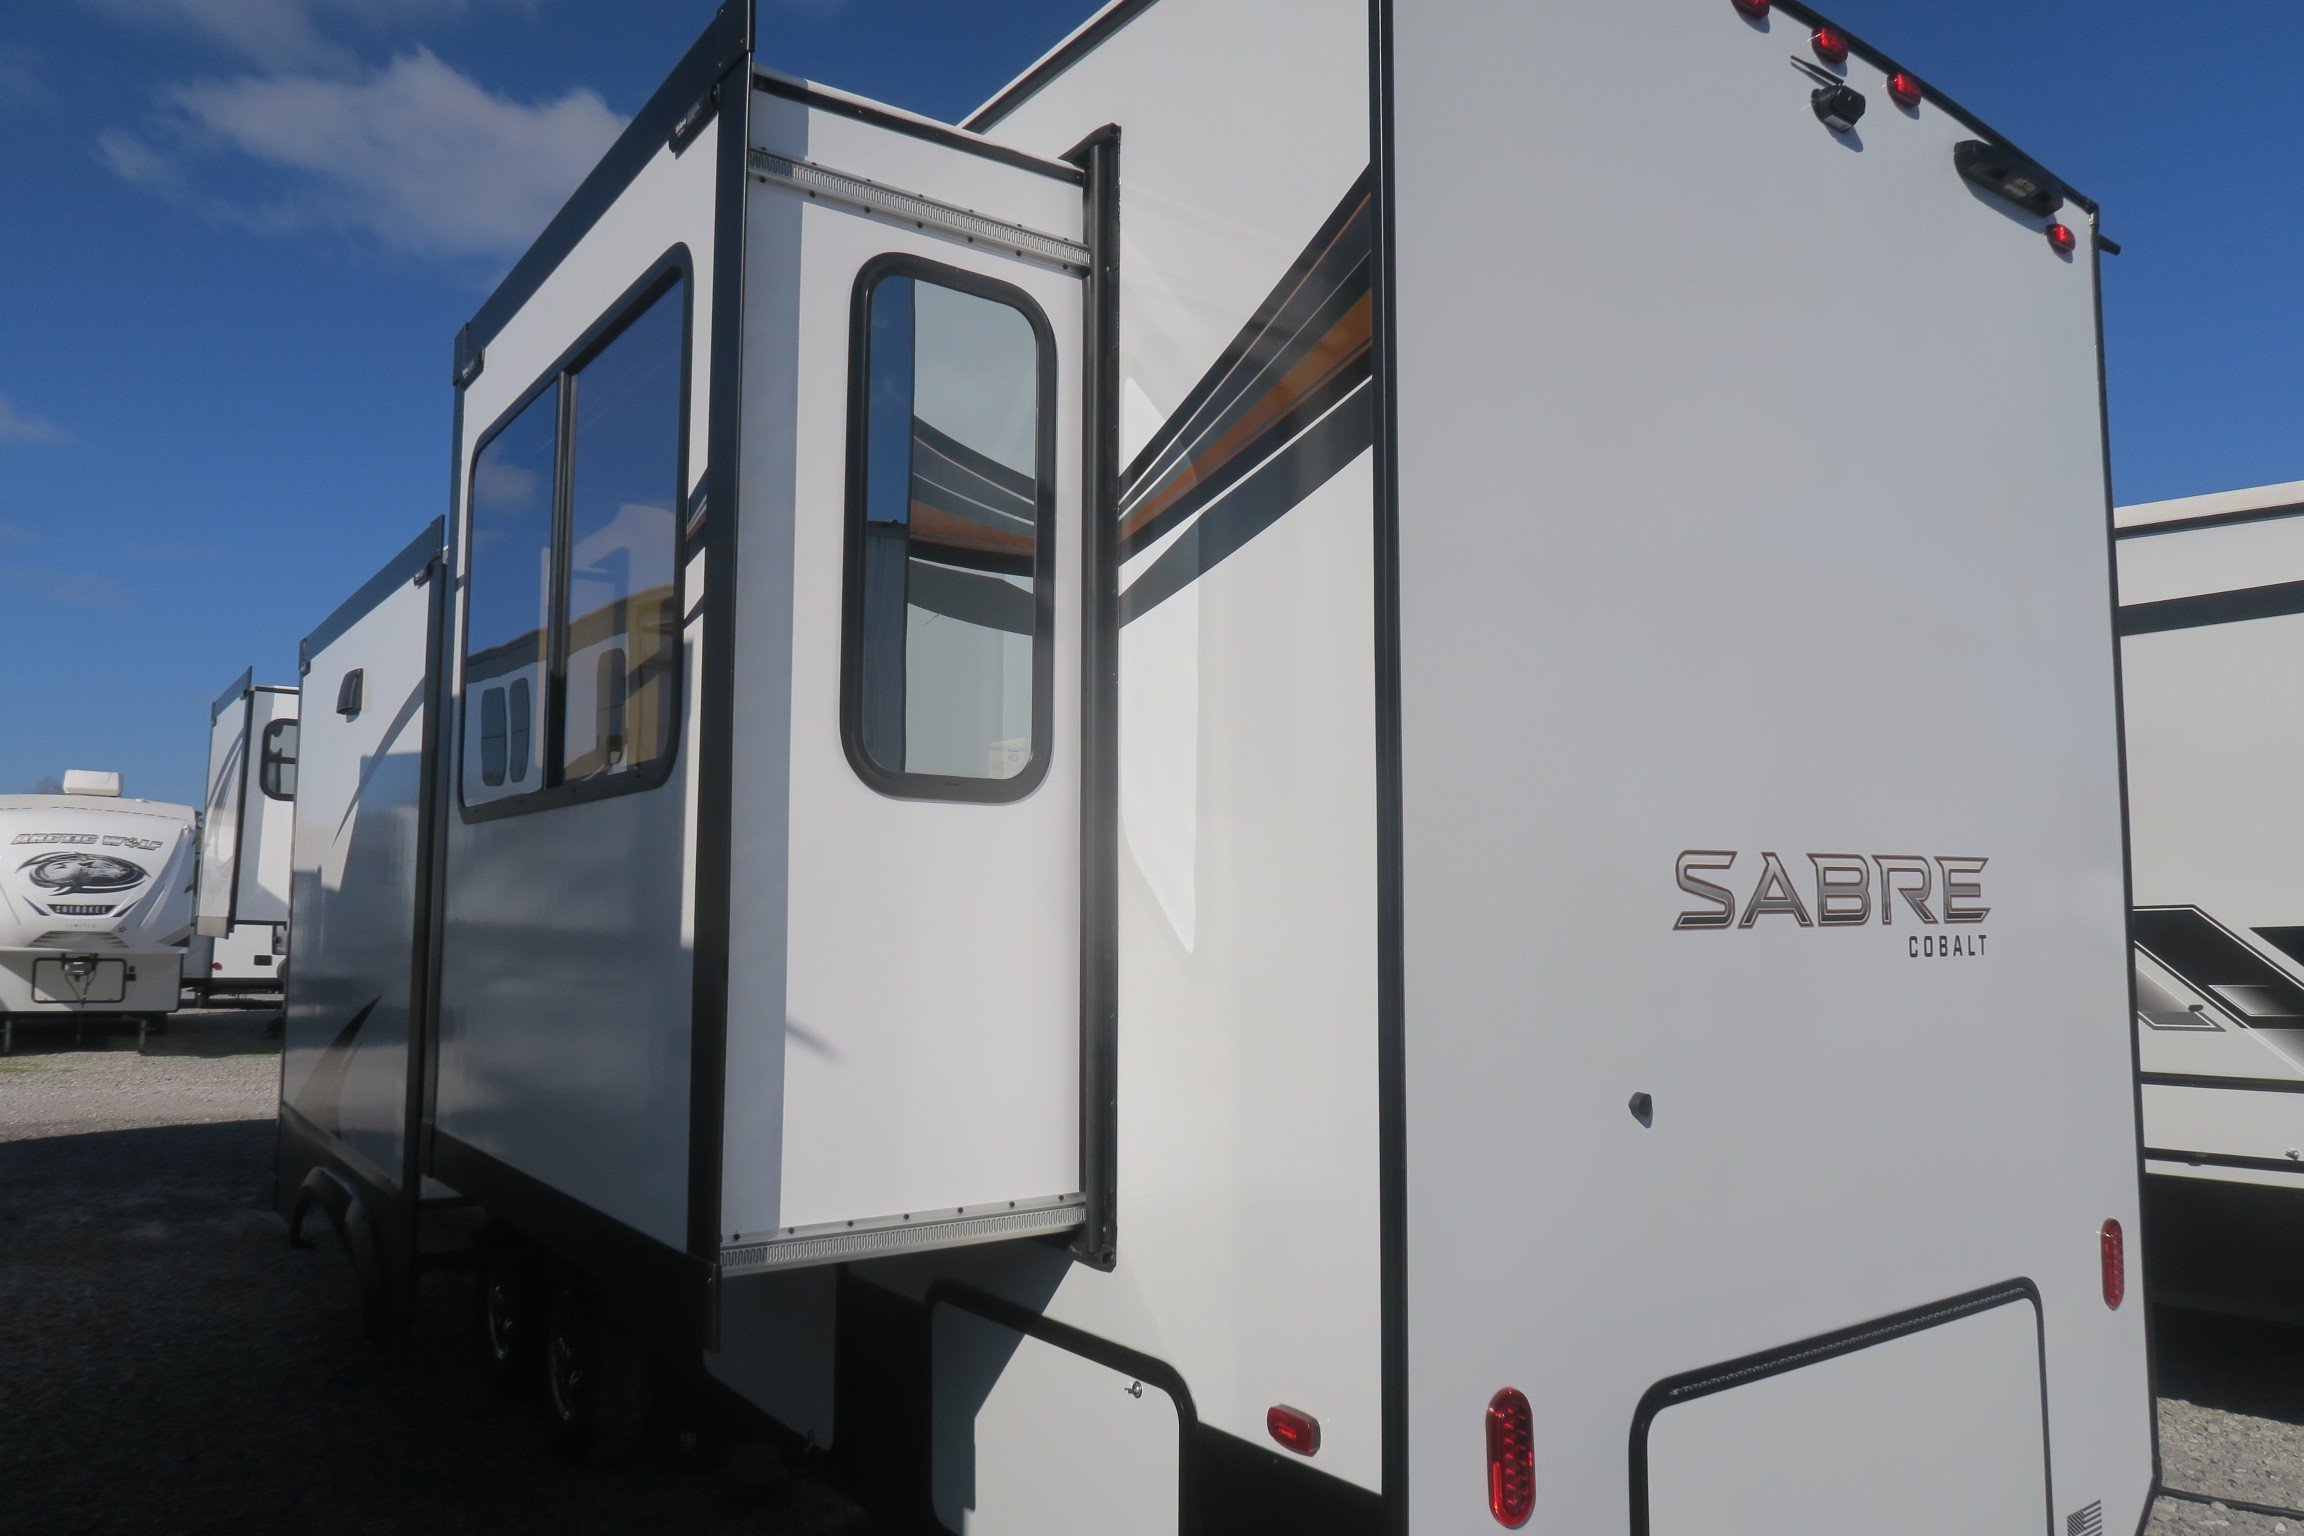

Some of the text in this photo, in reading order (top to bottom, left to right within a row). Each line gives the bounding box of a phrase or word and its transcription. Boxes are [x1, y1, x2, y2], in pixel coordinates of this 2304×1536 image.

[11, 833, 164, 850] ARCTIC WOLF
[1672, 849, 1991, 931] SABRE
[1908, 934, 1987, 958] COBALT
